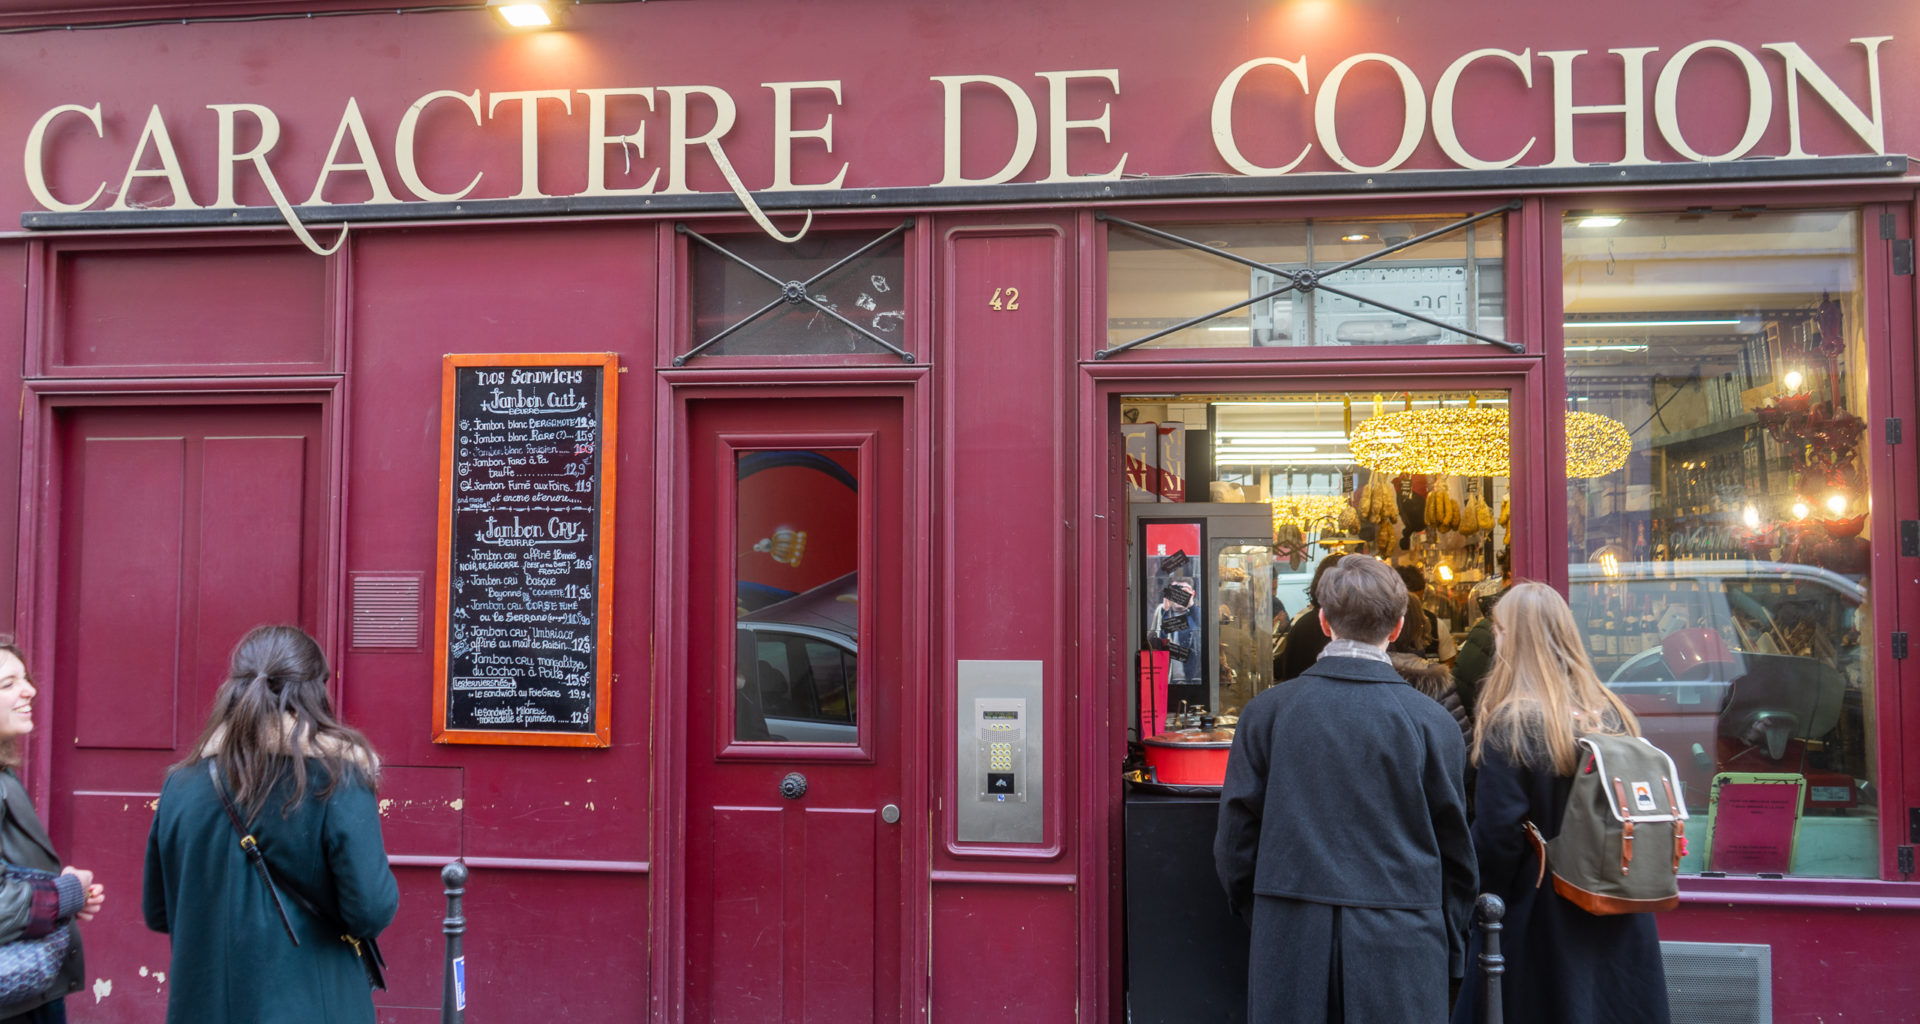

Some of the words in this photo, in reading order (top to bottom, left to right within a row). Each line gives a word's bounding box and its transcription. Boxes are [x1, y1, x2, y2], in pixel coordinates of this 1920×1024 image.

[24, 79, 850, 256] CARACTERE
[930, 68, 1129, 187] DE
[1211, 35, 1894, 175] COCHON
[988, 287, 1019, 311] 42
[490, 387, 544, 409] Jambon
[547, 388, 577, 407] Cuit
[474, 418, 505, 431] Jambon
[508, 418, 528, 430] blanc
[474, 430, 505, 444] Jambon
[508, 430, 528, 441] blanc
[473, 458, 507, 467] Jambon
[489, 467, 515, 478] truffe
[473, 480, 506, 491] Jambon
[534, 482, 549, 491] aux
[485, 516, 545, 538] Jambon
[471, 549, 503, 561] Jambon
[470, 575, 502, 586] Jambon
[525, 574, 556, 588] Basque
[470, 599, 506, 611] Jambon
[480, 614, 491, 622] ou
[471, 625, 508, 637] Jambon
[471, 638, 497, 652] affiné
[499, 640, 511, 649] au
[471, 652, 514, 665] Jambon
[472, 666, 484, 676] du
[486, 666, 526, 677] Cochon
[483, 688, 517, 698] sandwich
